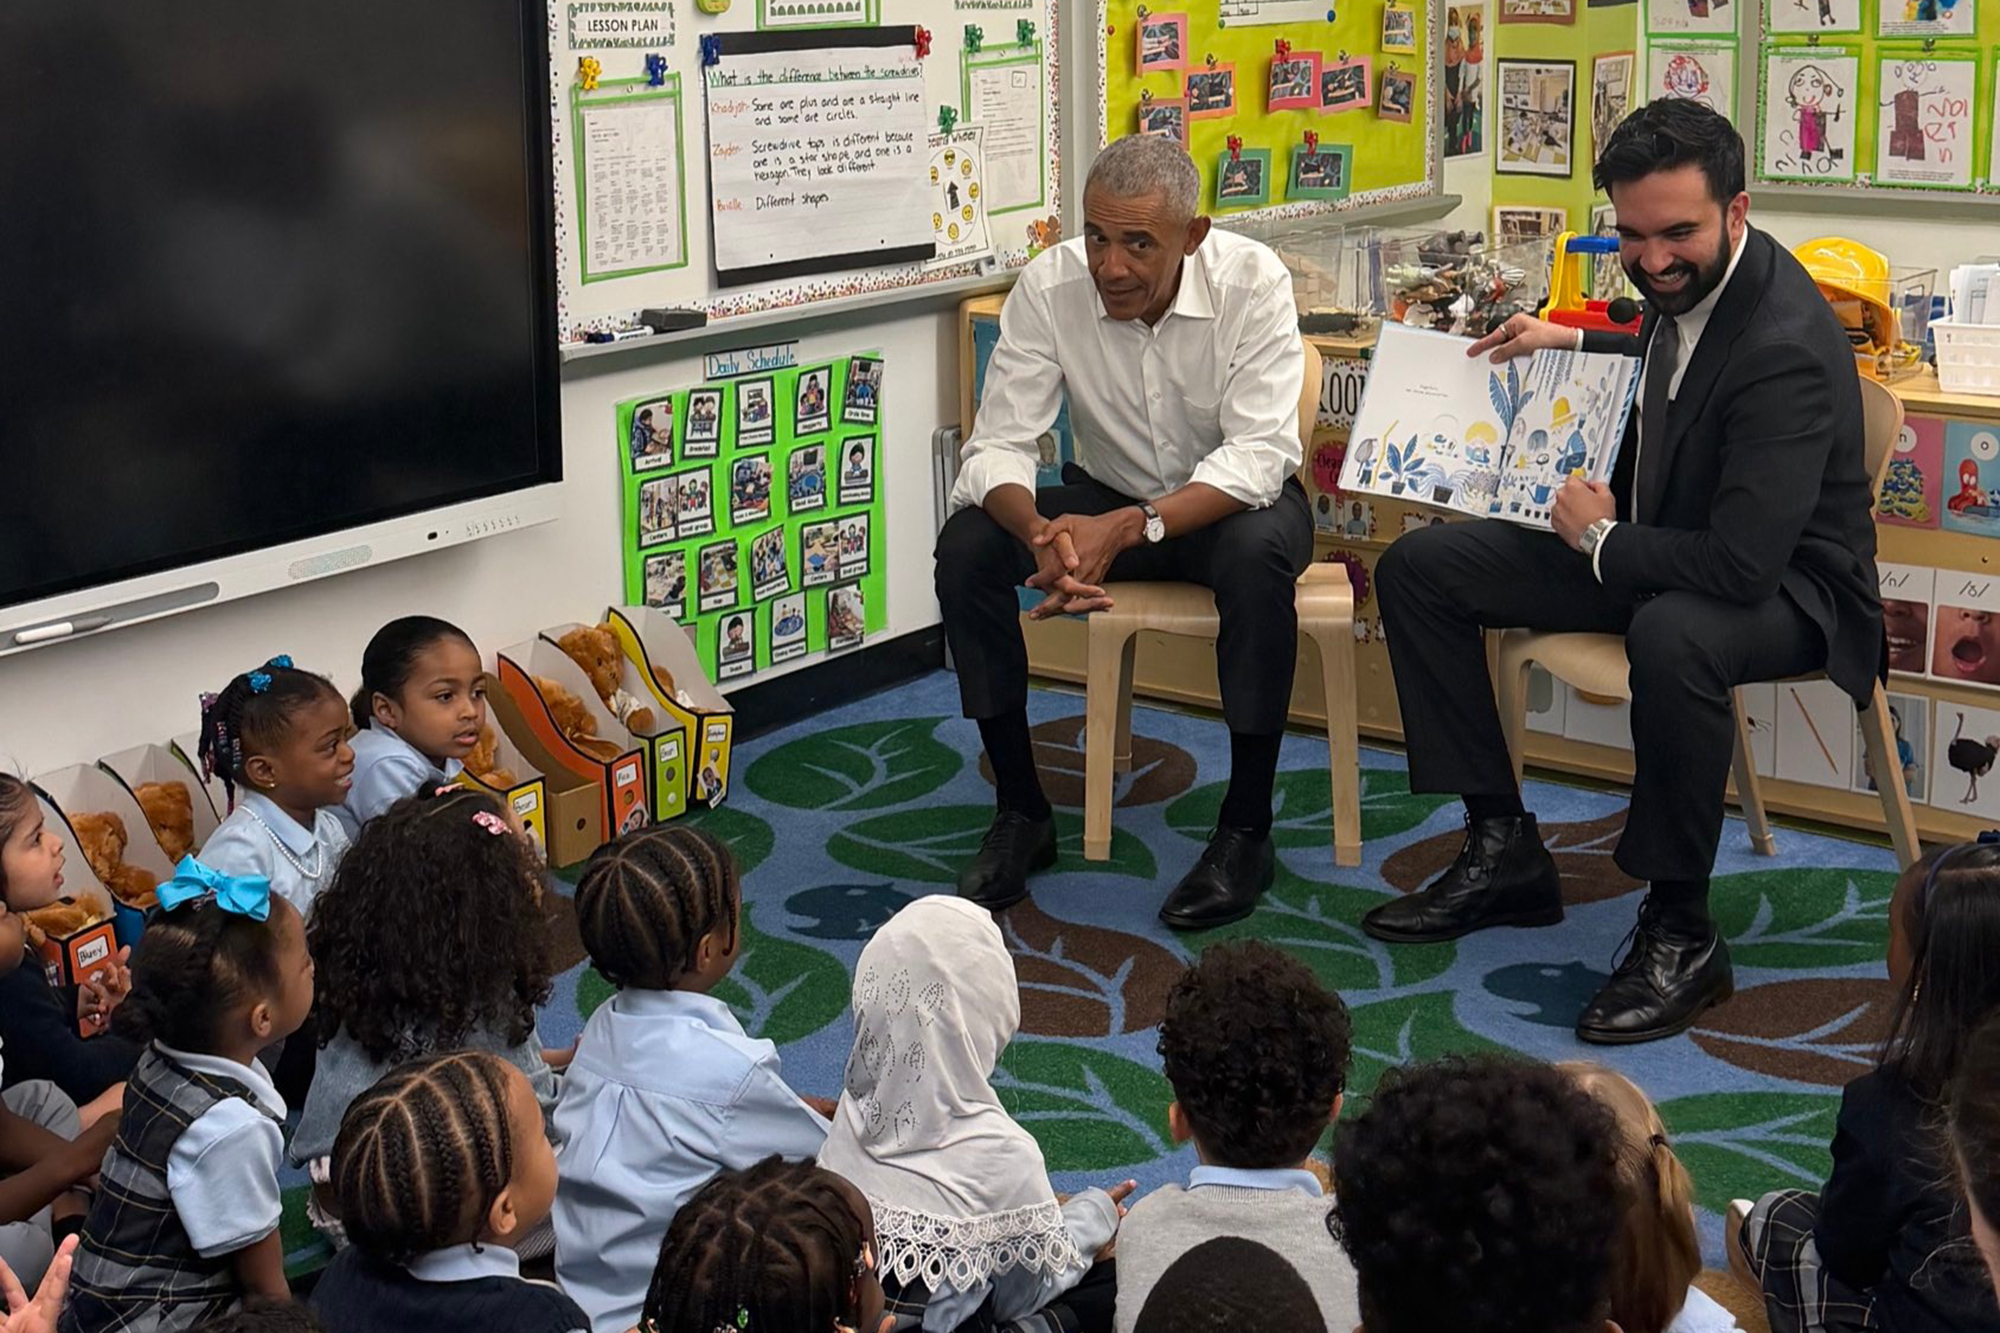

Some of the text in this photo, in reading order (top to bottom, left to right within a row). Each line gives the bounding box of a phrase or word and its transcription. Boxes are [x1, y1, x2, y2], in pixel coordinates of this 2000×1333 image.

[588, 19, 658, 32] LESSON PLAN
[708, 69, 738, 87] What
[744, 75, 752, 85] is
[757, 68, 774, 83] the
[779, 67, 822, 83] difference
[828, 65, 861, 81] between
[863, 65, 875, 78] the
[751, 97, 774, 111] Some
[800, 95, 817, 114] plus
[821, 95, 839, 107] and
[860, 96, 866, 105] a
[905, 92, 919, 103] line
[754, 108, 858, 126] and some are circles.
[832, 136, 840, 147] is
[843, 131, 880, 147] different
[774, 156, 782, 165] is
[789, 156, 795, 164] a
[799, 152, 818, 164] star
[854, 147, 872, 160] and
[875, 147, 890, 157] one
[893, 145, 901, 155] is
[906, 144, 912, 154] a
[790, 166, 811, 181] They
[817, 164, 834, 176] look
[755, 191, 795, 210] Different
[708, 345, 795, 376] Daily Schedule
[1319, 371, 1366, 415] OO
